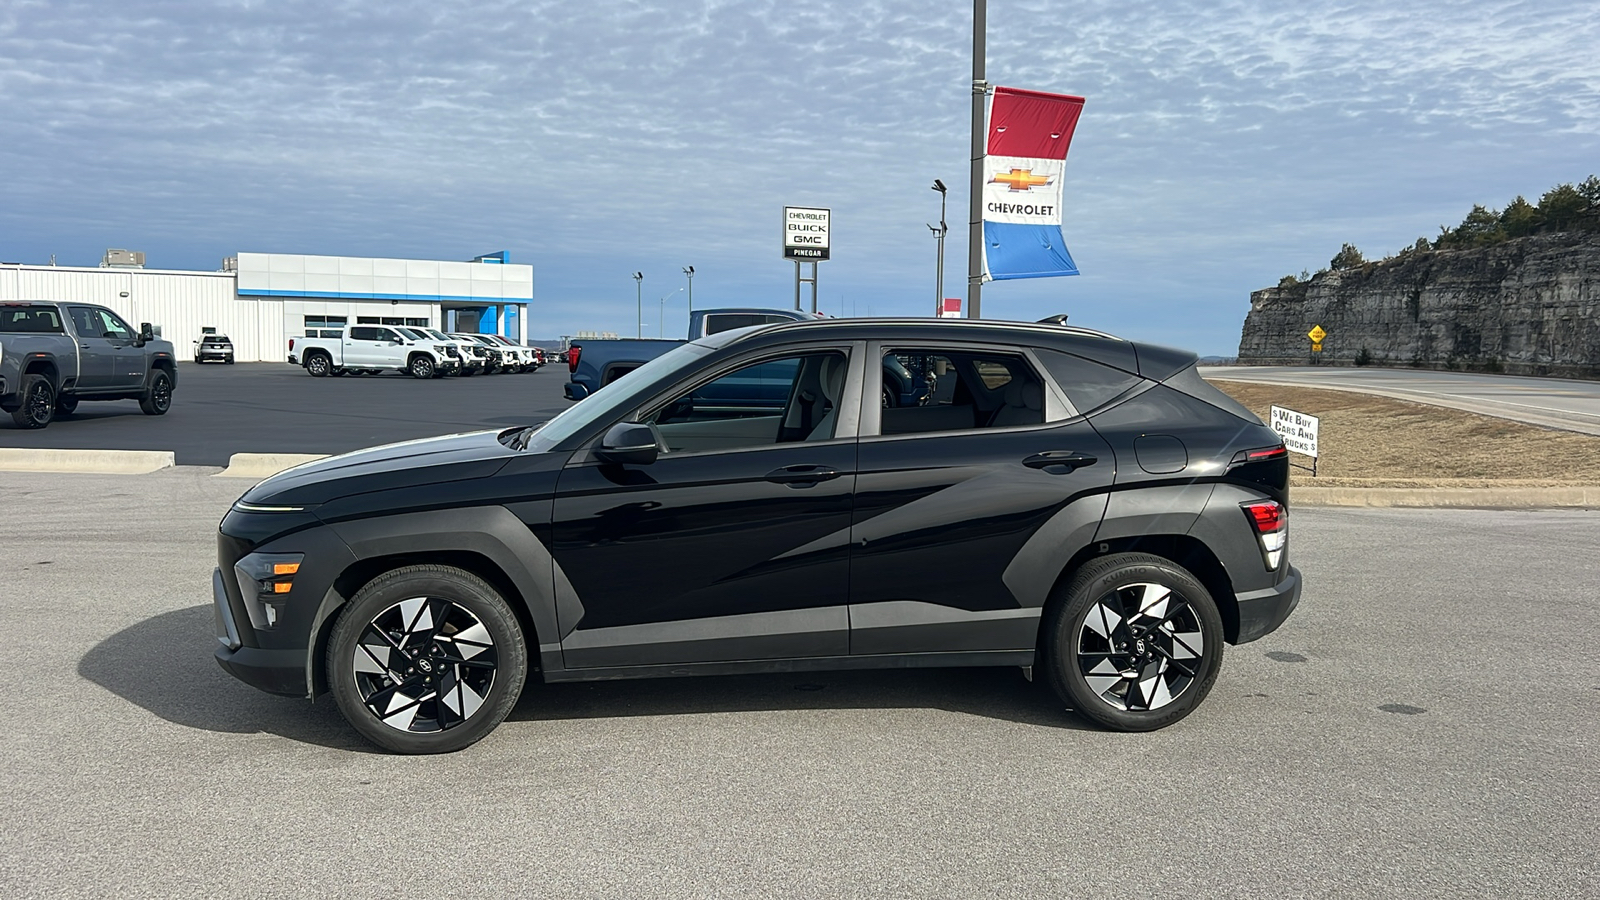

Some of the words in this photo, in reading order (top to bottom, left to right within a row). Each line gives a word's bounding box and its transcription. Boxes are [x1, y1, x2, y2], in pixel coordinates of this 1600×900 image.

[987, 202, 1054, 216] CHEVROLET
[789, 212, 827, 221] CHEVROLET
[788, 223, 827, 233] BUICK
[793, 235, 822, 244] GMC
[793, 249, 822, 257] PINEGAR
[1102, 567, 1147, 585] KUMHO
